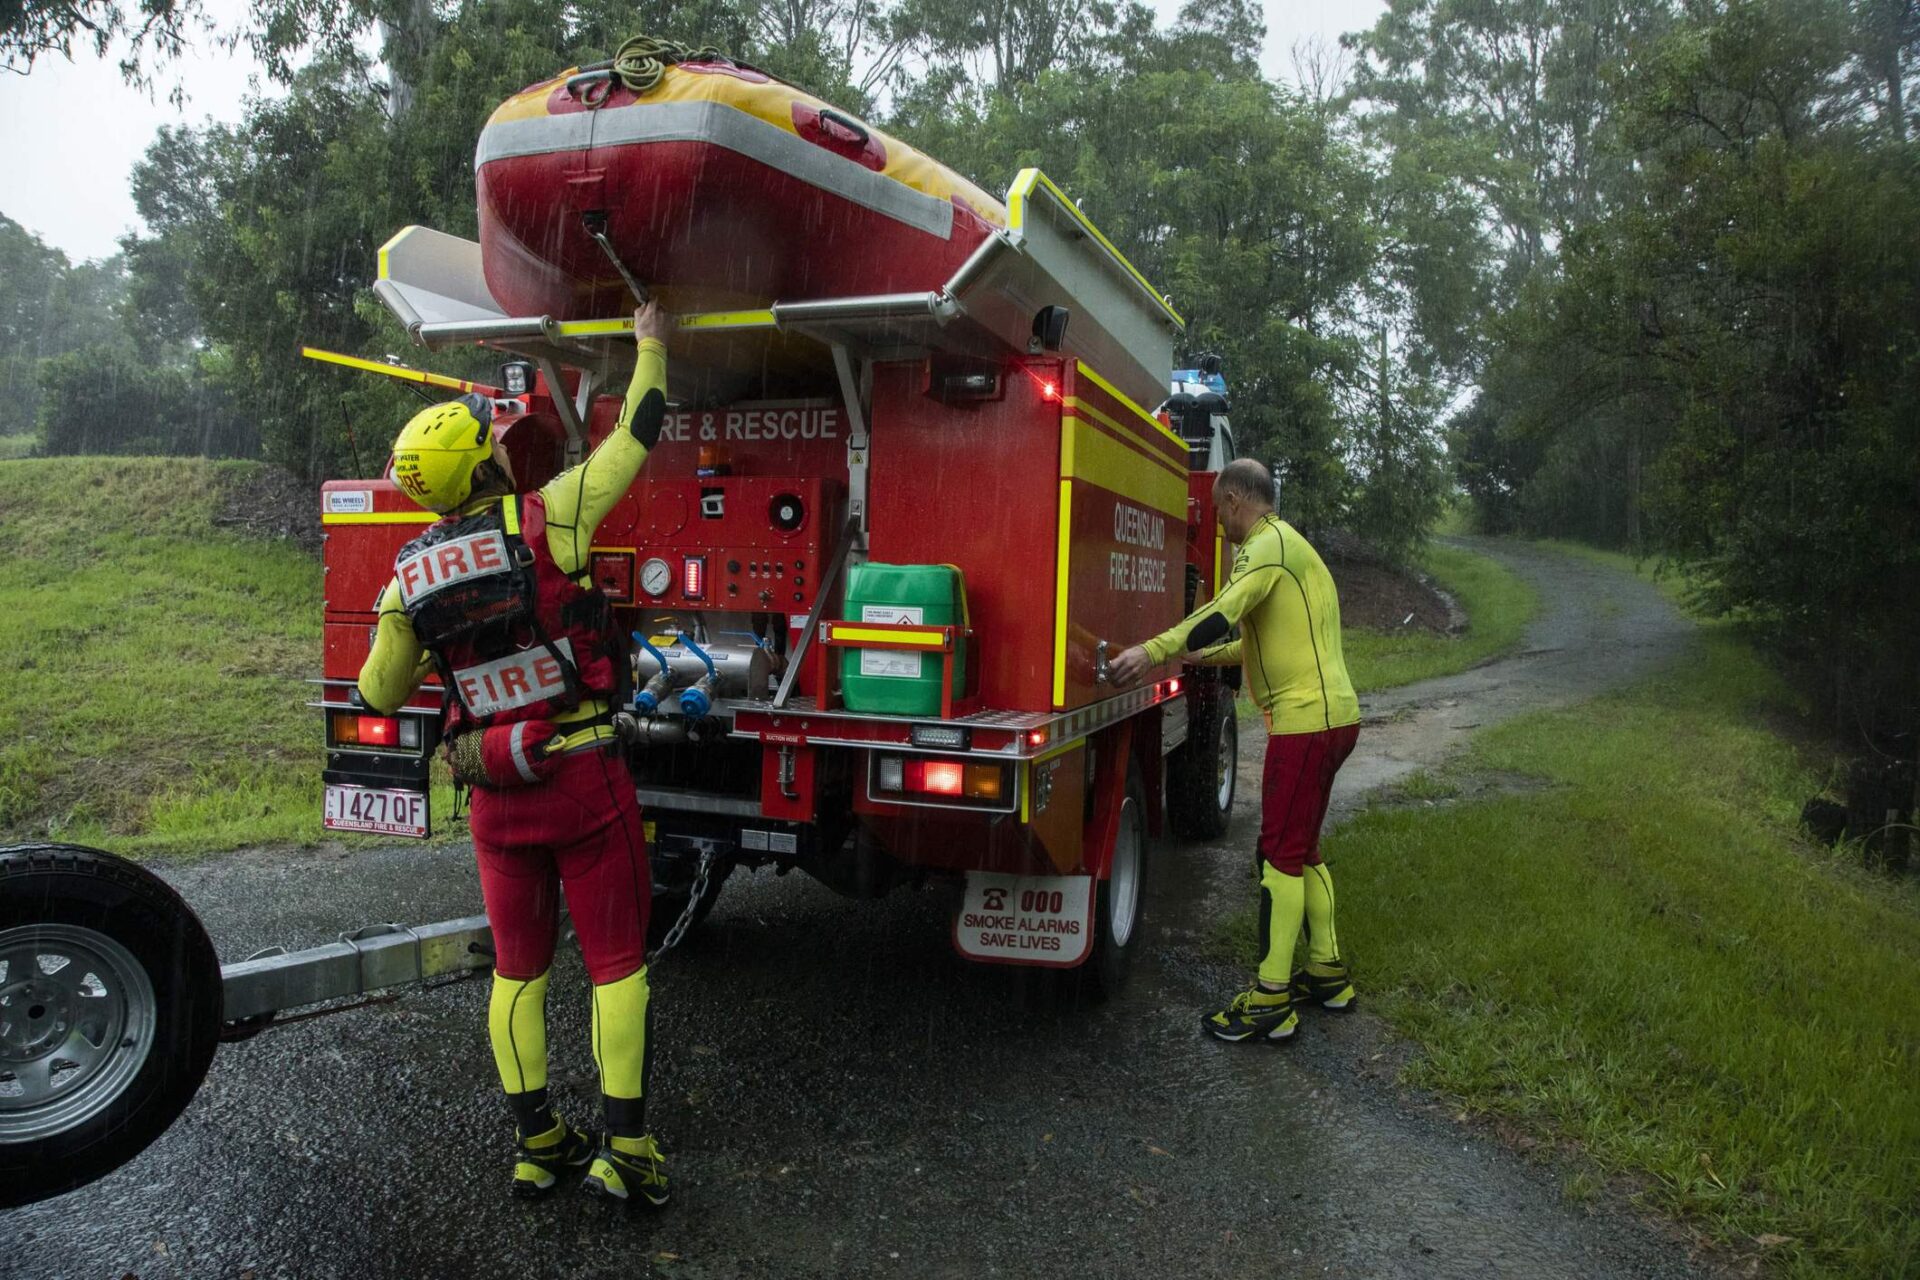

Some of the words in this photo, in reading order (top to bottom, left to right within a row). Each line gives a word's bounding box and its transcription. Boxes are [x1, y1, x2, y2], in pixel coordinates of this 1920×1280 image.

[658, 414, 691, 441] RE
[700, 413, 717, 440] &
[725, 410, 837, 440] RESCUE
[1115, 502, 1165, 551] QUEENSLAND
[402, 537, 502, 597] FIRE
[1110, 552, 1129, 591] FIRE
[1131, 555, 1137, 592] &
[1138, 557, 1166, 593] RESCUE
[460, 656, 562, 707] FIRE
[786, 735, 799, 743] HOSE
[332, 819, 373, 829] QUEENSLAND
[374, 822, 388, 831] FIRE
[394, 825, 418, 834] RESCUE
[1021, 890, 1063, 913] 000
[963, 914, 1015, 930] SMOKE
[1018, 918, 1081, 935] ALARMS
[980, 933, 1017, 948] SAVE
[1020, 935, 1061, 951] LIVES
